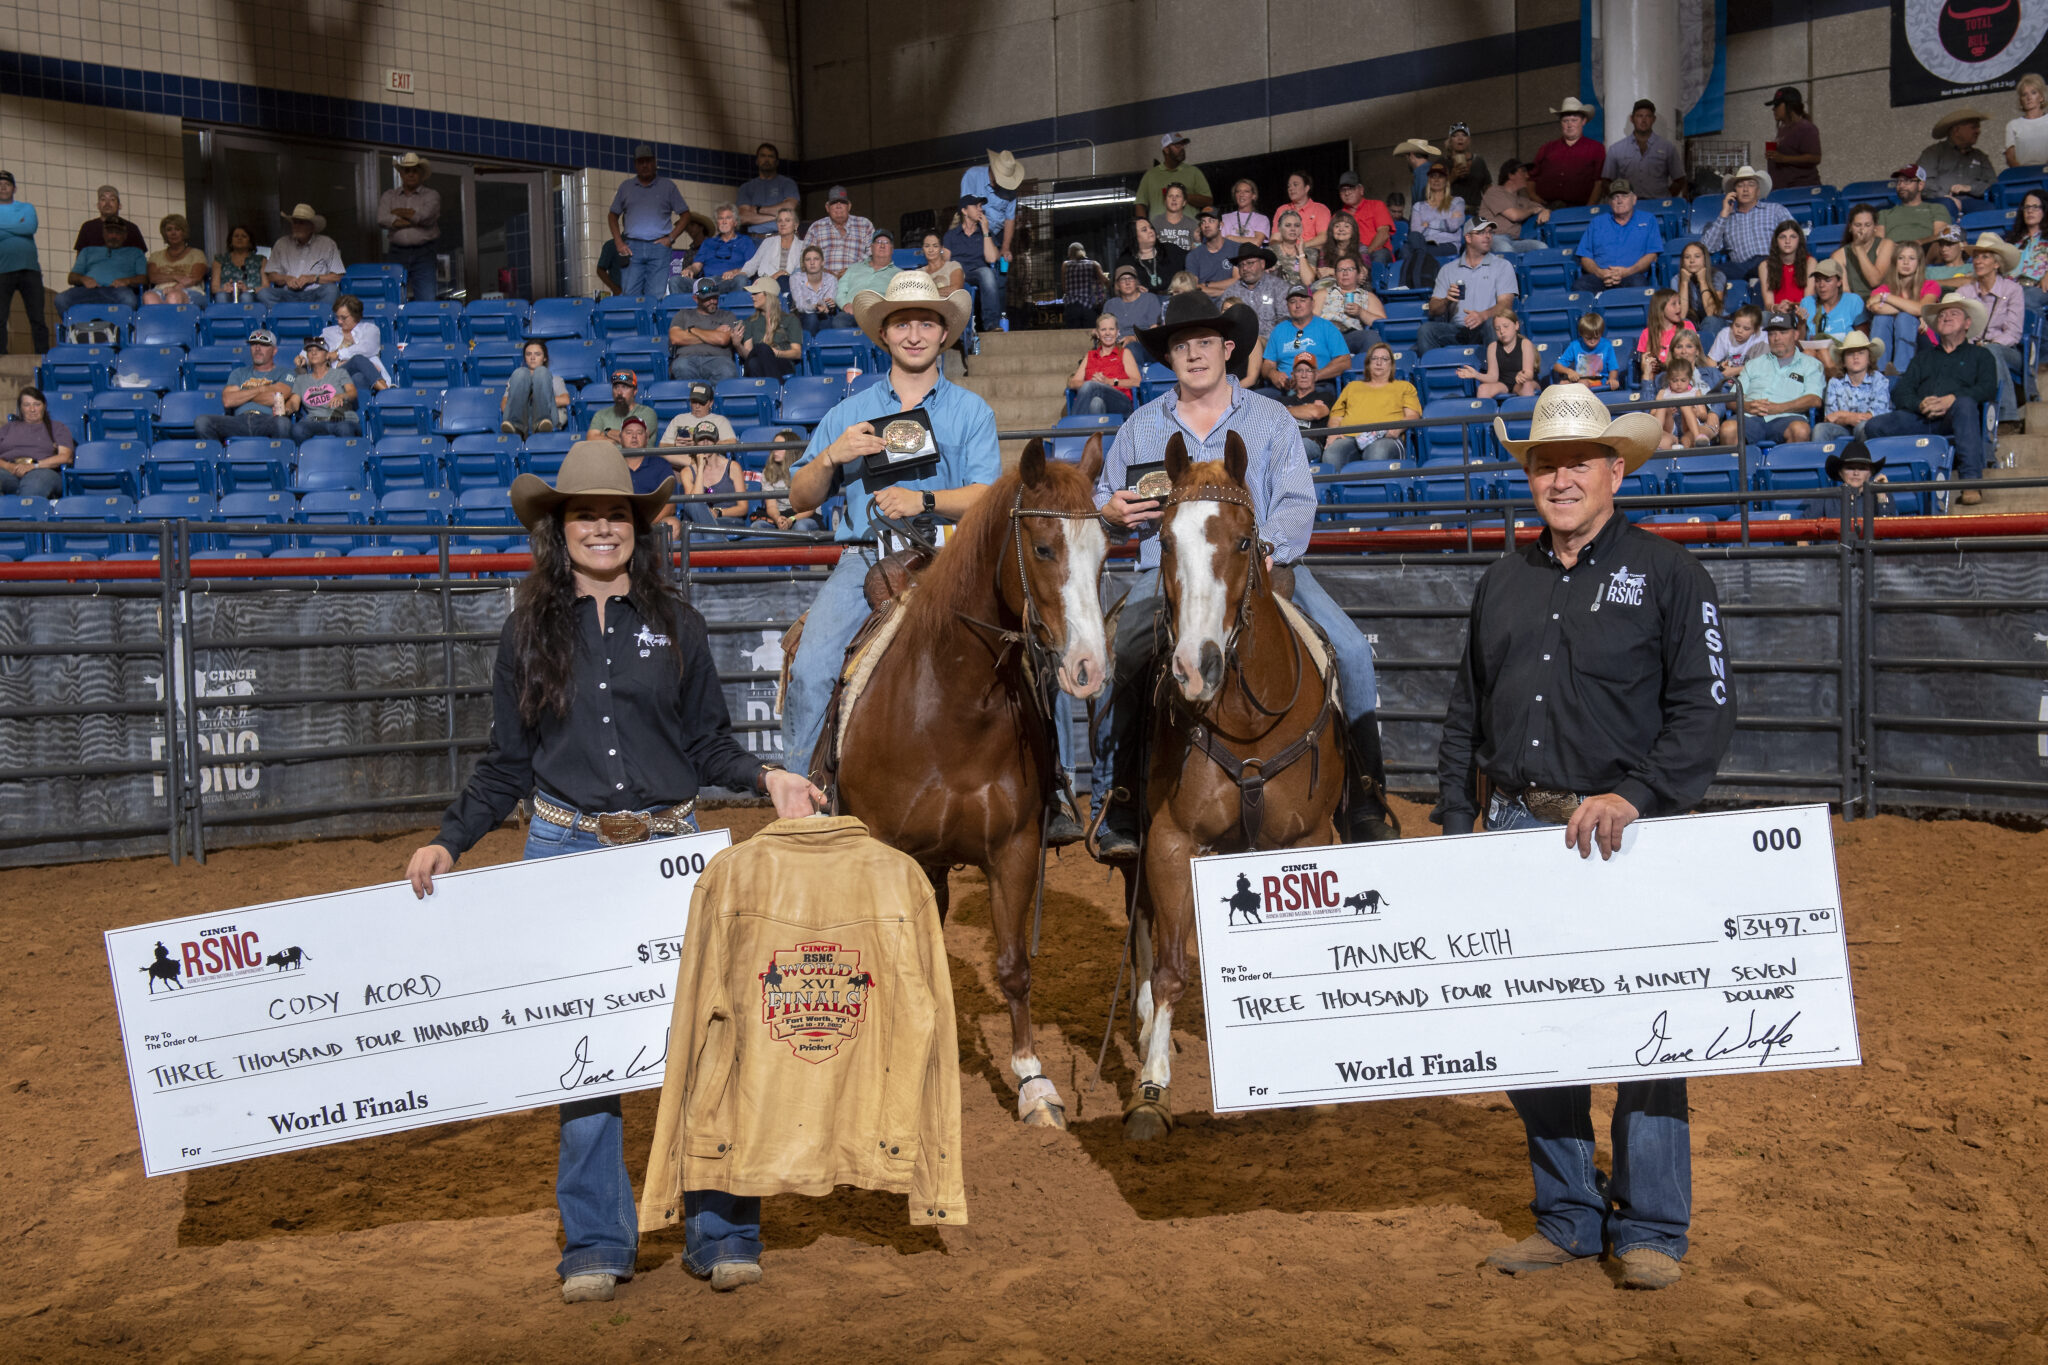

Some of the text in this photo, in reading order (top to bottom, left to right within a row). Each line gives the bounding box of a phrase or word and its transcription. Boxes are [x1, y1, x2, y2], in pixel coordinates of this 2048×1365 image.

[1965, 16, 1992, 31] TOTAL
[1968, 34, 1990, 48] BULL
[392, 71, 411, 89] EXIT
[308, 385, 328, 393] SELF
[309, 394, 331, 405] MADE
[1606, 586, 1643, 606] RSNC
[209, 669, 256, 681] CINCH
[1752, 827, 1801, 852] 000
[660, 852, 705, 879] 000
[1281, 863, 1318, 872] CINCH
[1262, 870, 1340, 913] RSNC
[200, 925, 237, 937] CINCH
[181, 931, 262, 978] RSNC
[1328, 928, 1513, 970] TANNER KEITH
[803, 953, 833, 963] RSNC
[779, 963, 853, 977] WORLD
[1221, 966, 1236, 976] Pay
[800, 979, 834, 989] XVI
[1238, 973, 1261, 982] Order
[1232, 994, 1305, 1021] THREE
[1316, 988, 1429, 1009] THOUSAND
[1441, 983, 1492, 1003] FOUR
[1504, 977, 1605, 997] HUNDRED
[1636, 968, 1710, 989] NINETY
[1731, 957, 1797, 982] SEVEN
[1723, 984, 1795, 1003] DOLLARS
[269, 974, 441, 1020] CODY ACORD
[767, 991, 861, 1020] FINALS
[145, 1034, 159, 1043] Pay
[147, 1061, 223, 1087] THREE
[233, 1043, 343, 1072] THOUSAND
[356, 1030, 406, 1051] FOUR
[413, 1016, 489, 1043] HUNDRED
[525, 998, 594, 1022] NINETY
[604, 984, 666, 1010] SEVEN
[163, 1038, 186, 1048] Order
[188, 1035, 198, 1043] Of
[1335, 1050, 1497, 1082] World Finals
[1249, 1086, 1269, 1096] For
[268, 1090, 429, 1135] World Finals
[181, 1147, 201, 1157] For
